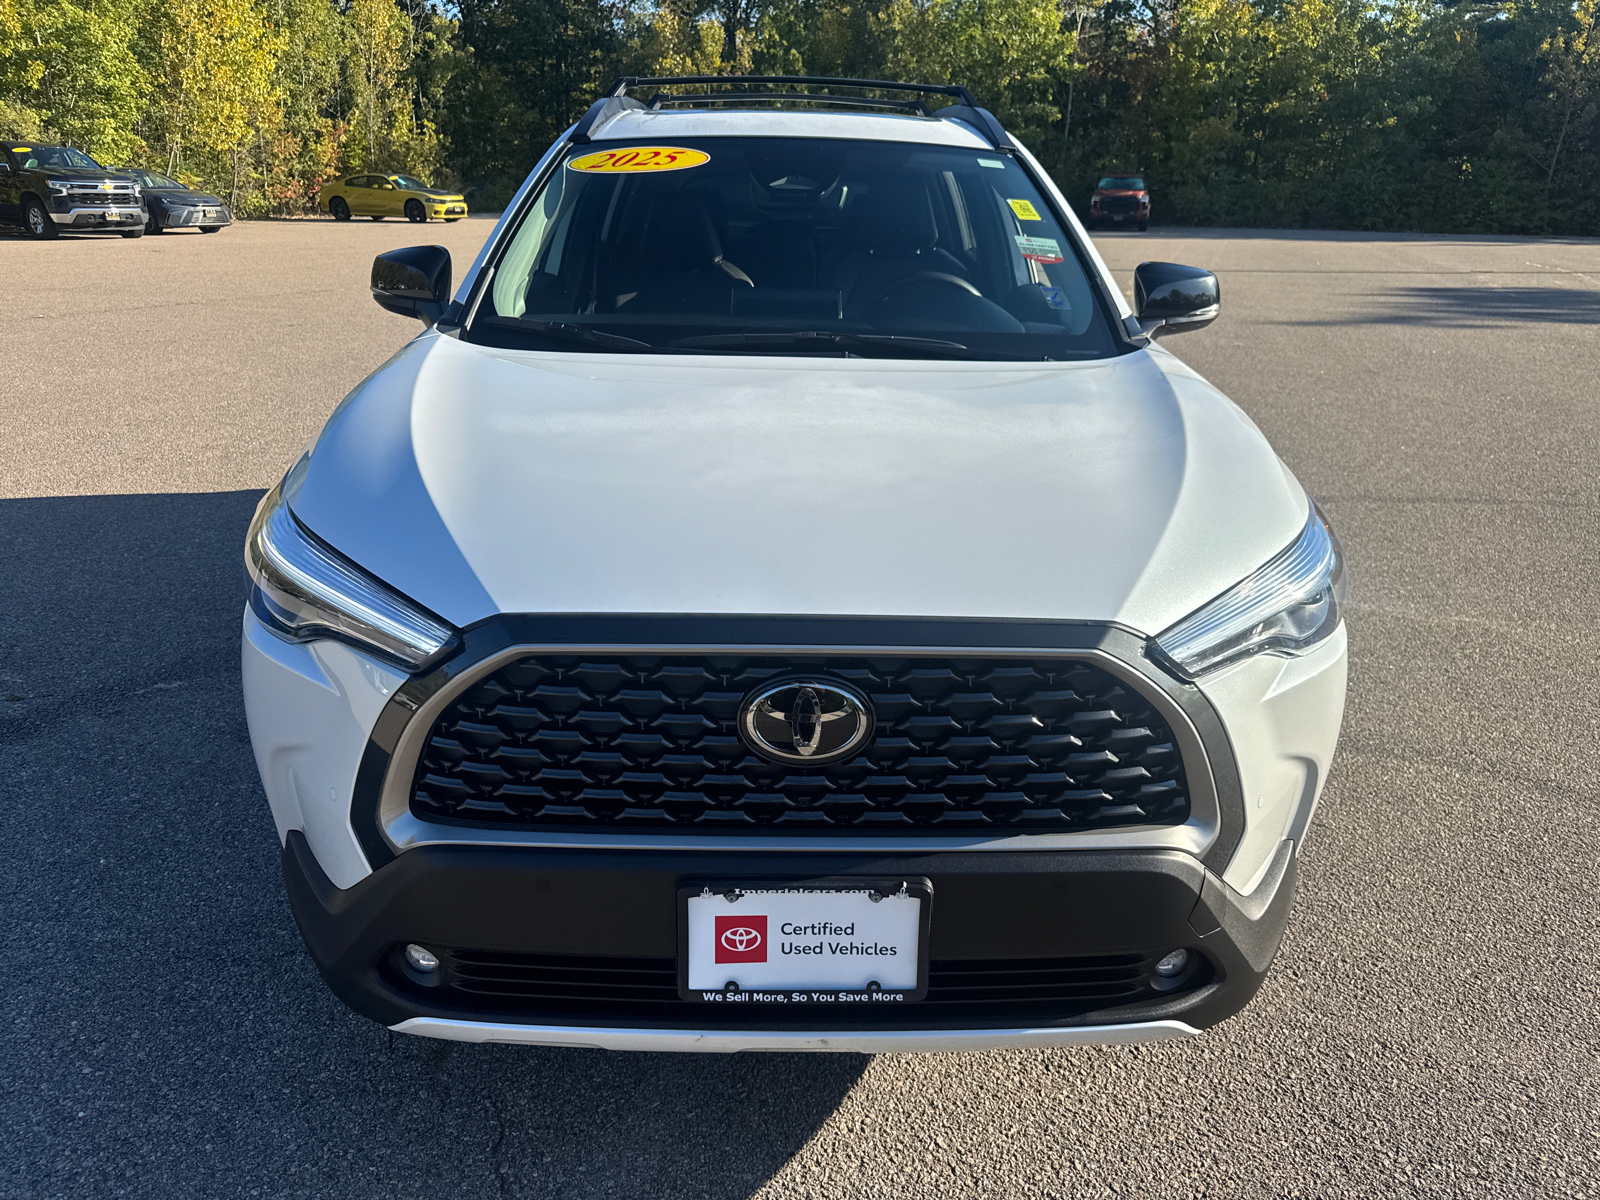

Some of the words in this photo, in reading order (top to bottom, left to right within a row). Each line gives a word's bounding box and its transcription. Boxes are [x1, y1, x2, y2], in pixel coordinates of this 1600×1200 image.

[585, 151, 686, 169] 2025
[780, 922, 855, 936] Certified
[781, 942, 823, 955] Used
[828, 942, 897, 956] Vehicles
[703, 992, 722, 1001] We
[726, 992, 749, 1002] Sell
[753, 993, 788, 1003] More,
[792, 993, 807, 1002] So
[811, 993, 835, 1002] You
[838, 993, 868, 1002] Save
[872, 993, 904, 1002] More
